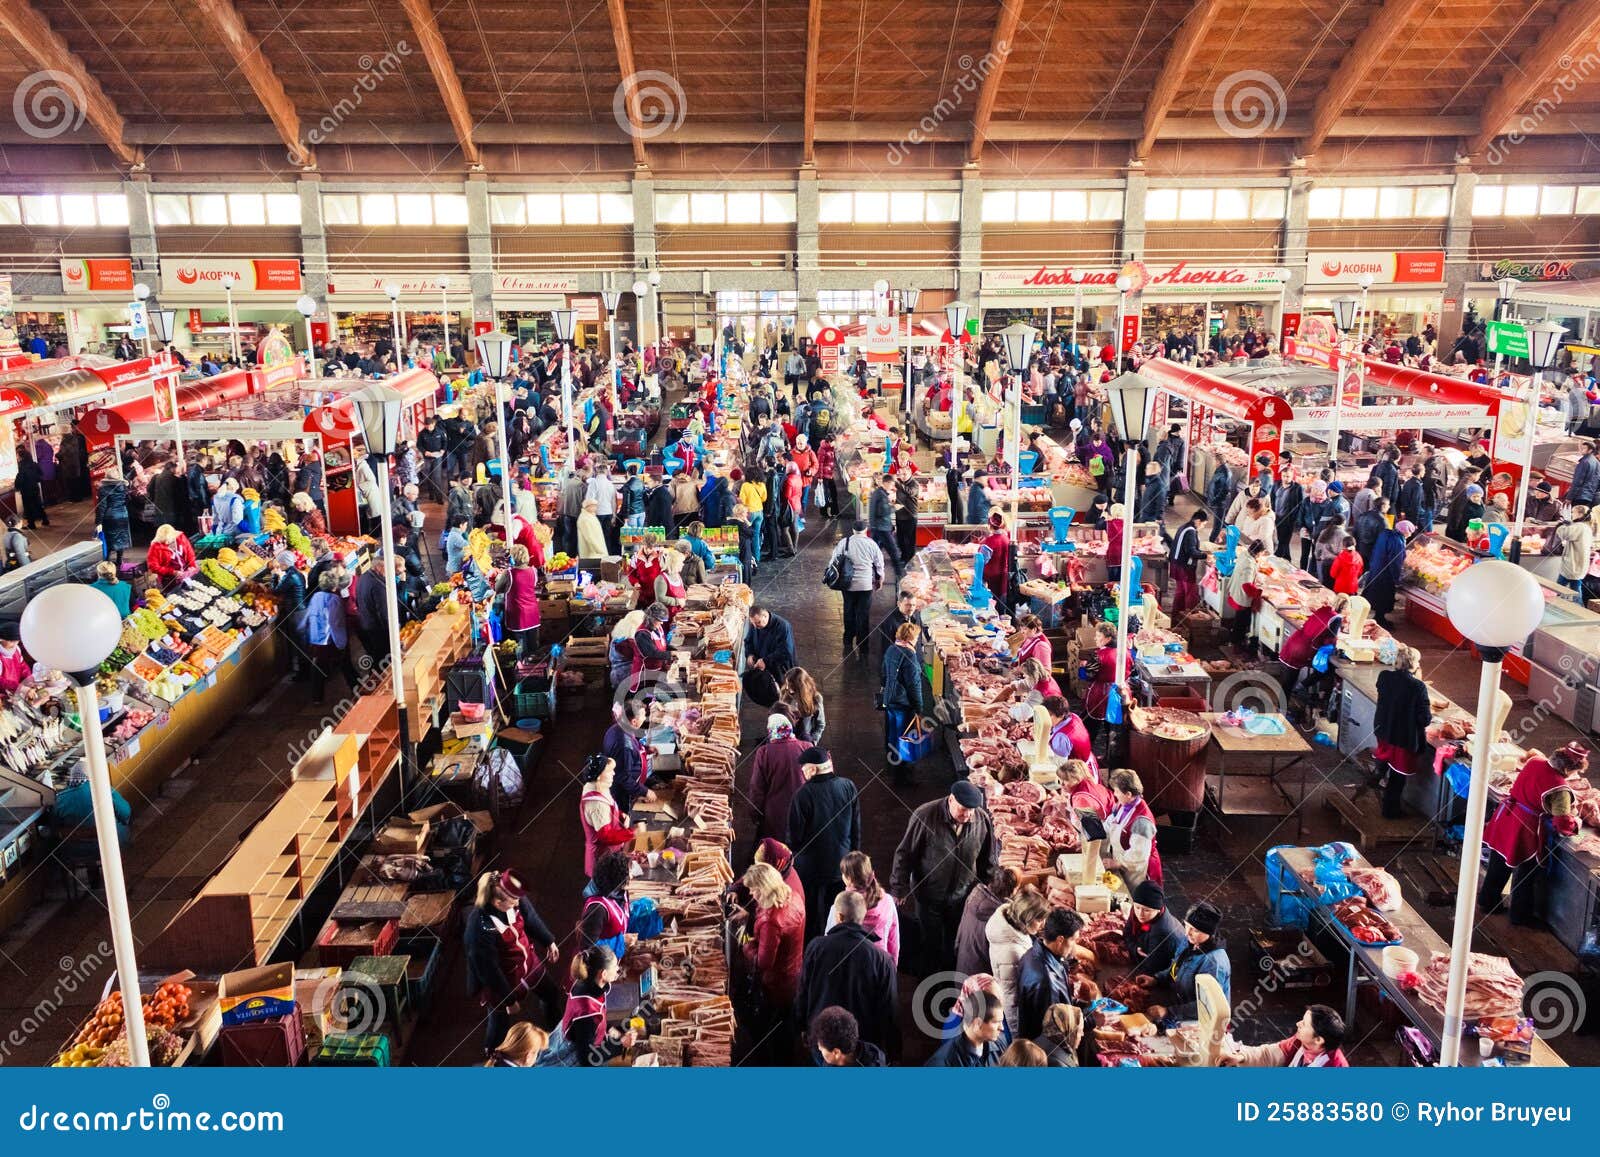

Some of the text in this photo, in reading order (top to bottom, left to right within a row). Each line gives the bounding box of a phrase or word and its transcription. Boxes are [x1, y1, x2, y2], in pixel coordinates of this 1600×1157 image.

[1023, 265, 1118, 285] Любмая
[1153, 259, 1248, 284] Аленка
[1343, 264, 1383, 273] АСОБІНА
